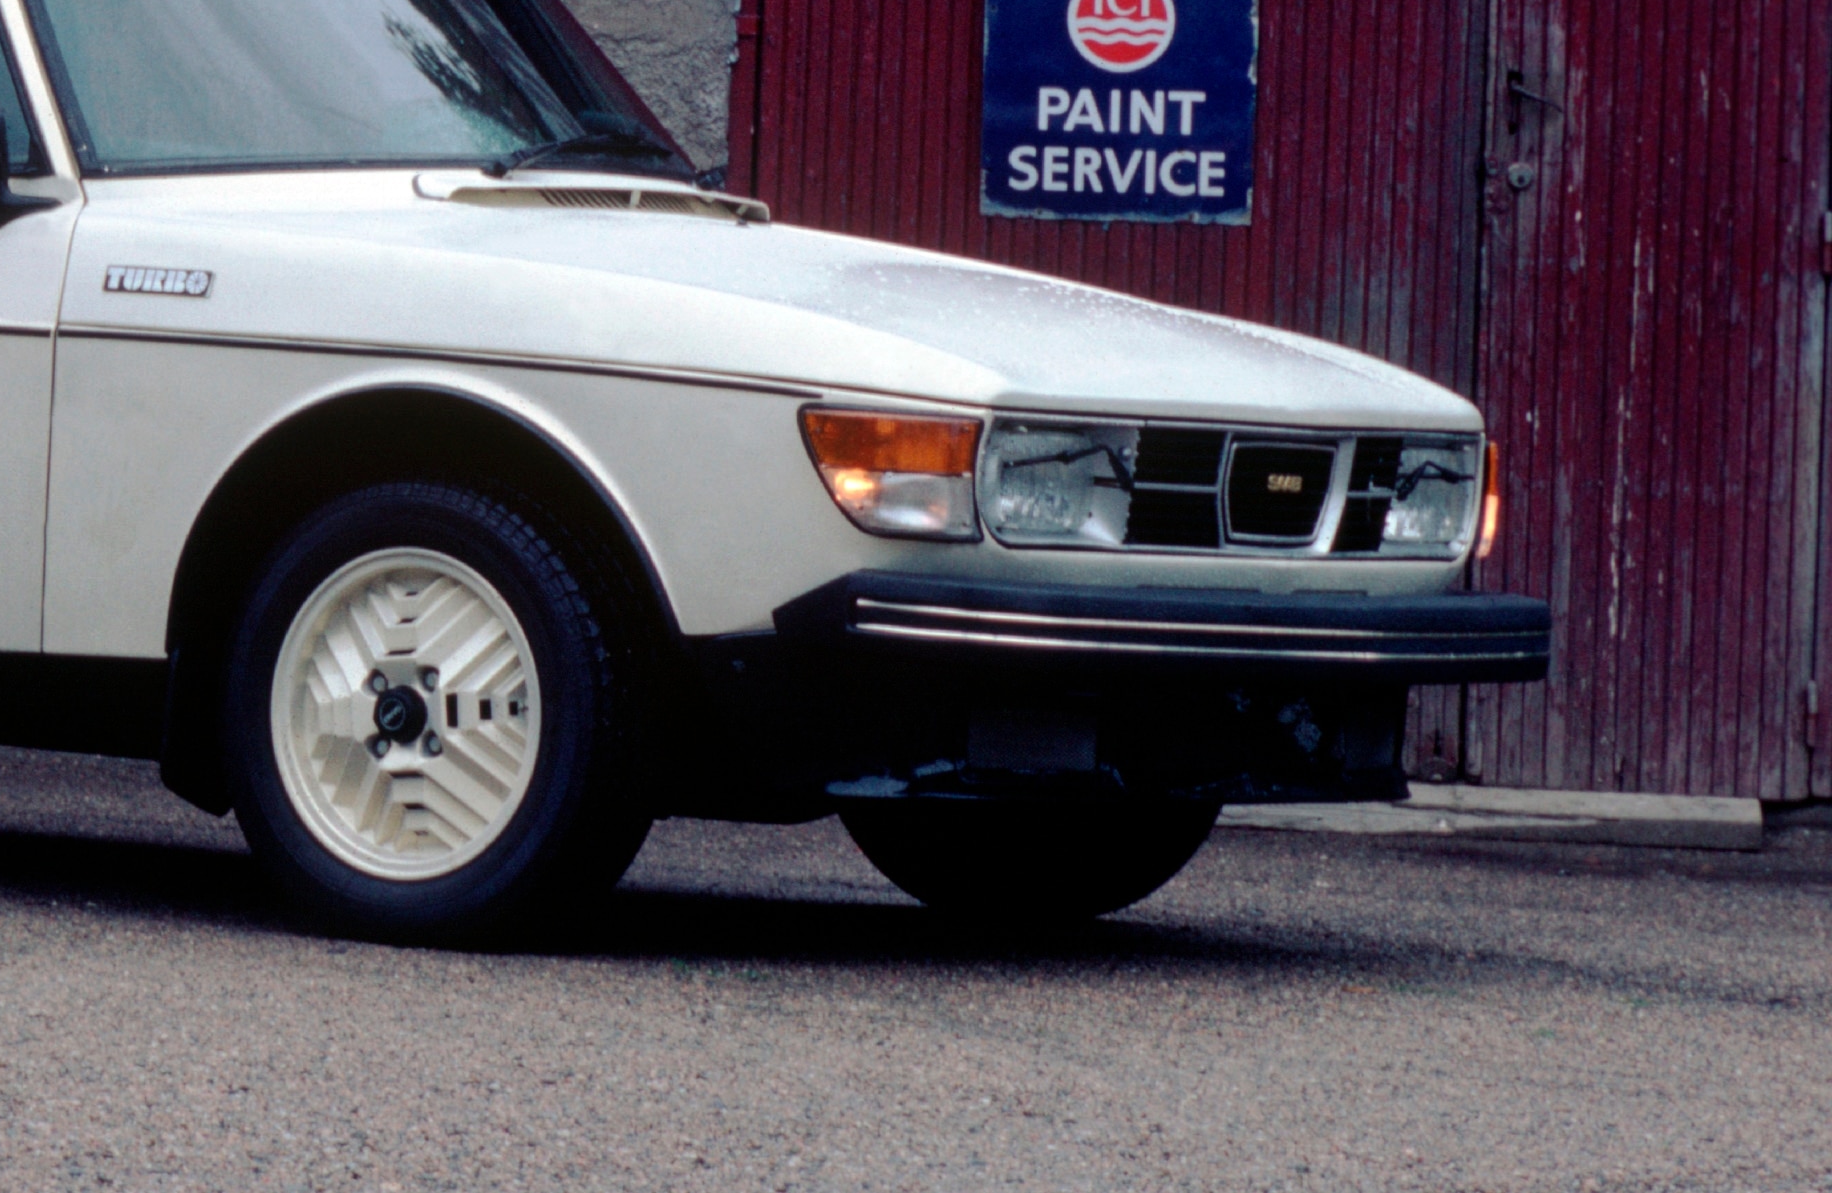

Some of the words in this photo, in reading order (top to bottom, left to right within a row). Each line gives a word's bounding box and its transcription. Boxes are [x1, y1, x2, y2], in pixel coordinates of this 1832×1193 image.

[1037, 86, 1207, 137] PAINT
[1007, 144, 1226, 198] SERVICE
[105, 265, 212, 297] TURBO
